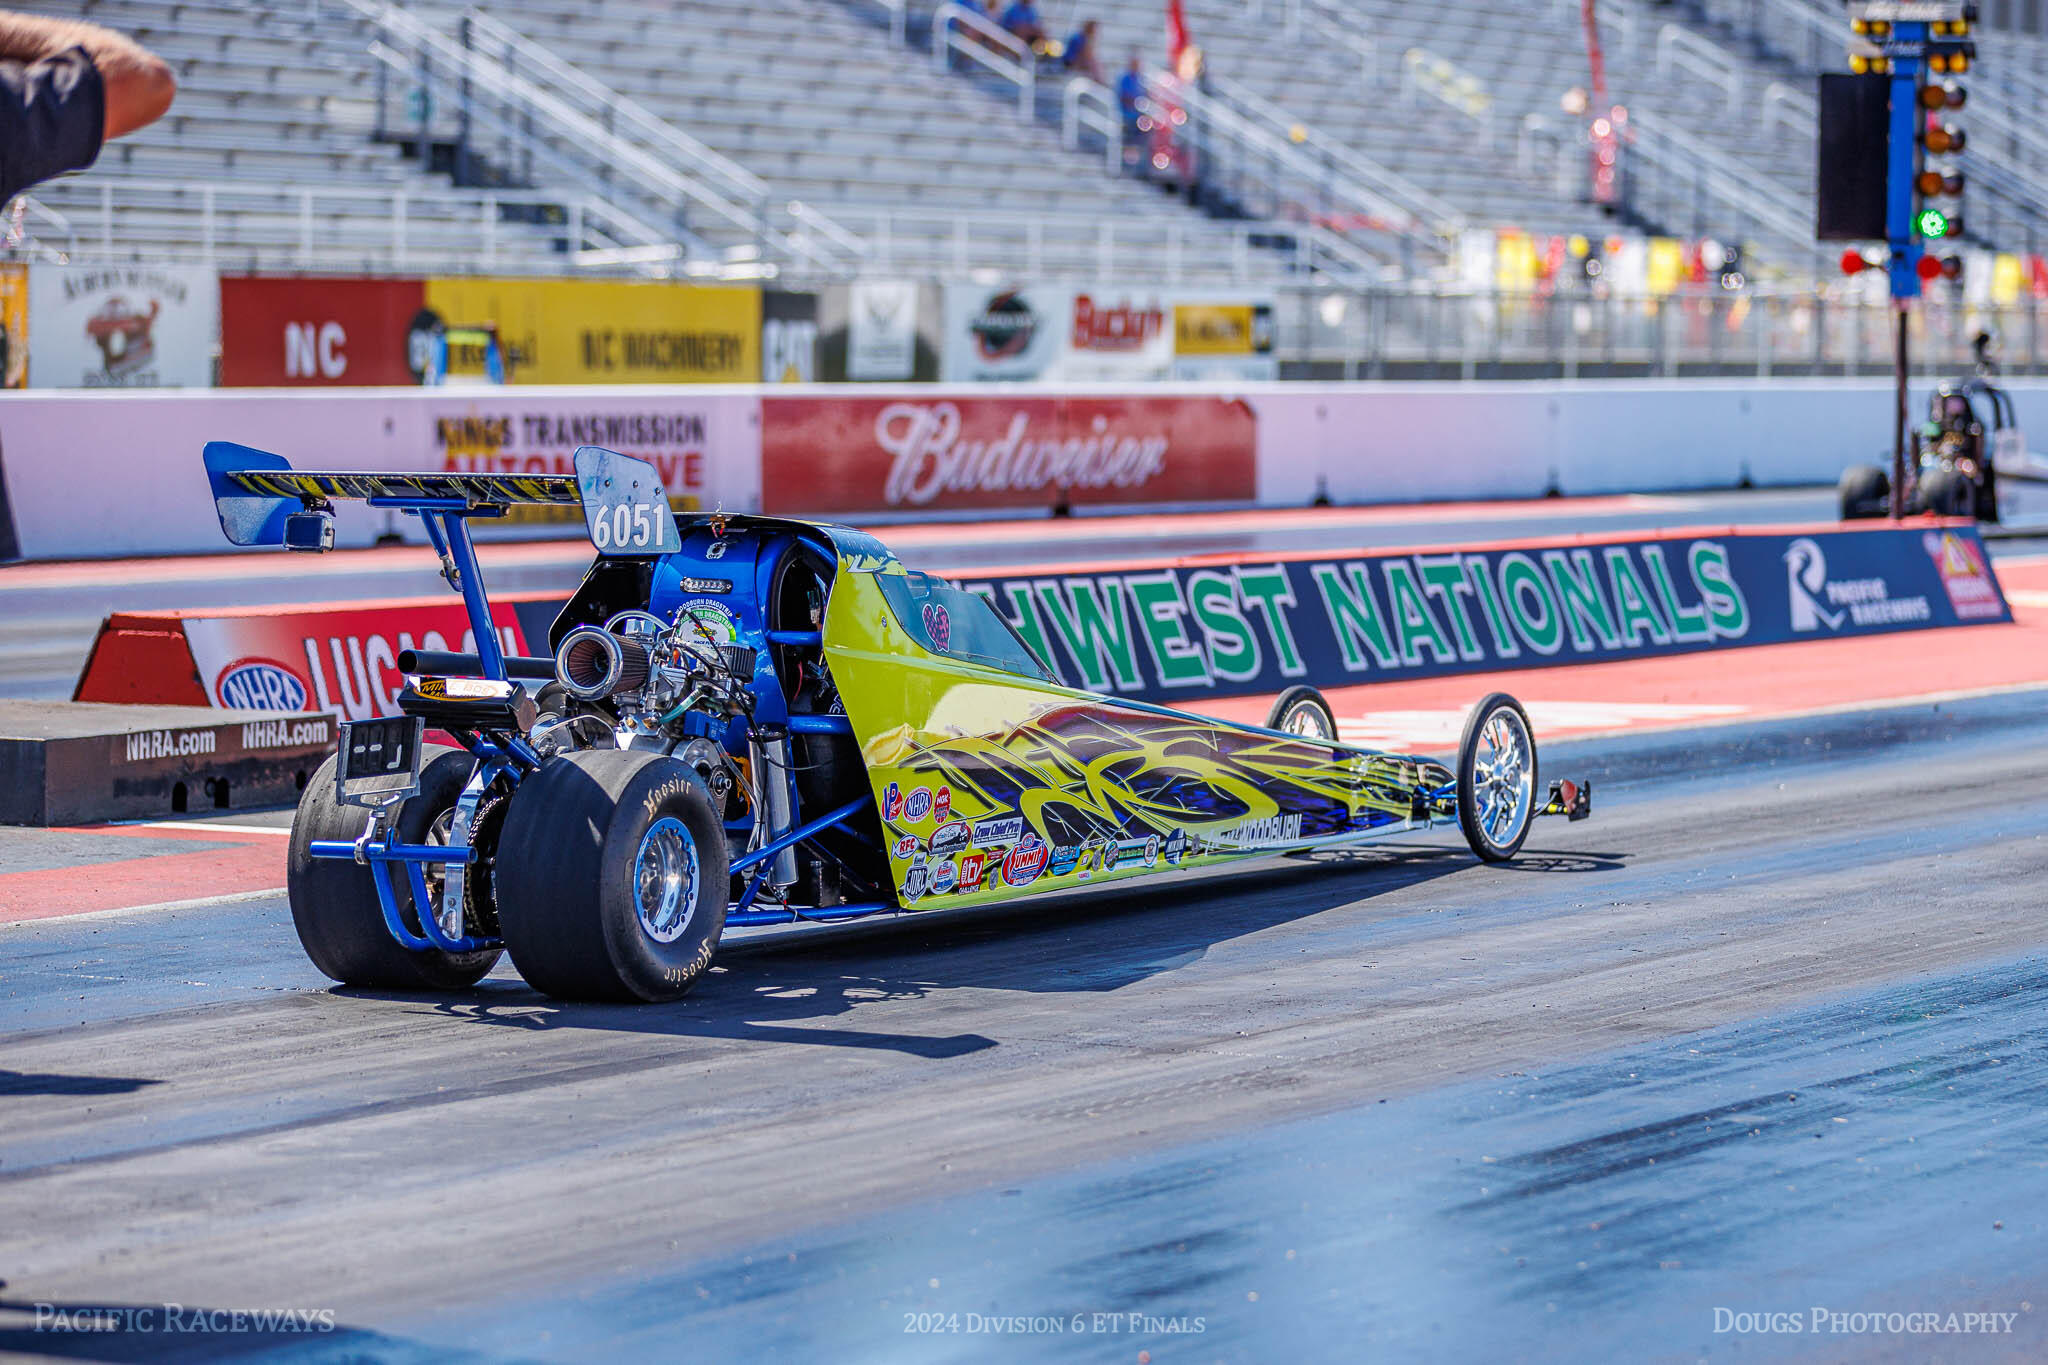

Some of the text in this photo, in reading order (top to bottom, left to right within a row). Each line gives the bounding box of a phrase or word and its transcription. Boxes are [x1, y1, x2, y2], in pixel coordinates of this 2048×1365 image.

[285, 321, 346, 378] NC
[436, 415, 706, 448] KINGS TRANSMISSION
[875, 401, 1168, 505] Budweiser
[593, 502, 666, 548] 6051
[705, 598, 733, 617] DRAGSTRIP
[1311, 540, 1750, 672] NATIONALS
[226, 666, 302, 711] NHRA
[126, 730, 217, 761] NHRA.com
[241, 719, 329, 749] NHRA.com
[643, 772, 692, 822] Hoosier
[908, 793, 930, 817] NHRA
[899, 838, 916, 853] RFC
[1240, 813, 1302, 844] WOODBURN
[664, 937, 713, 987] Hoosier
